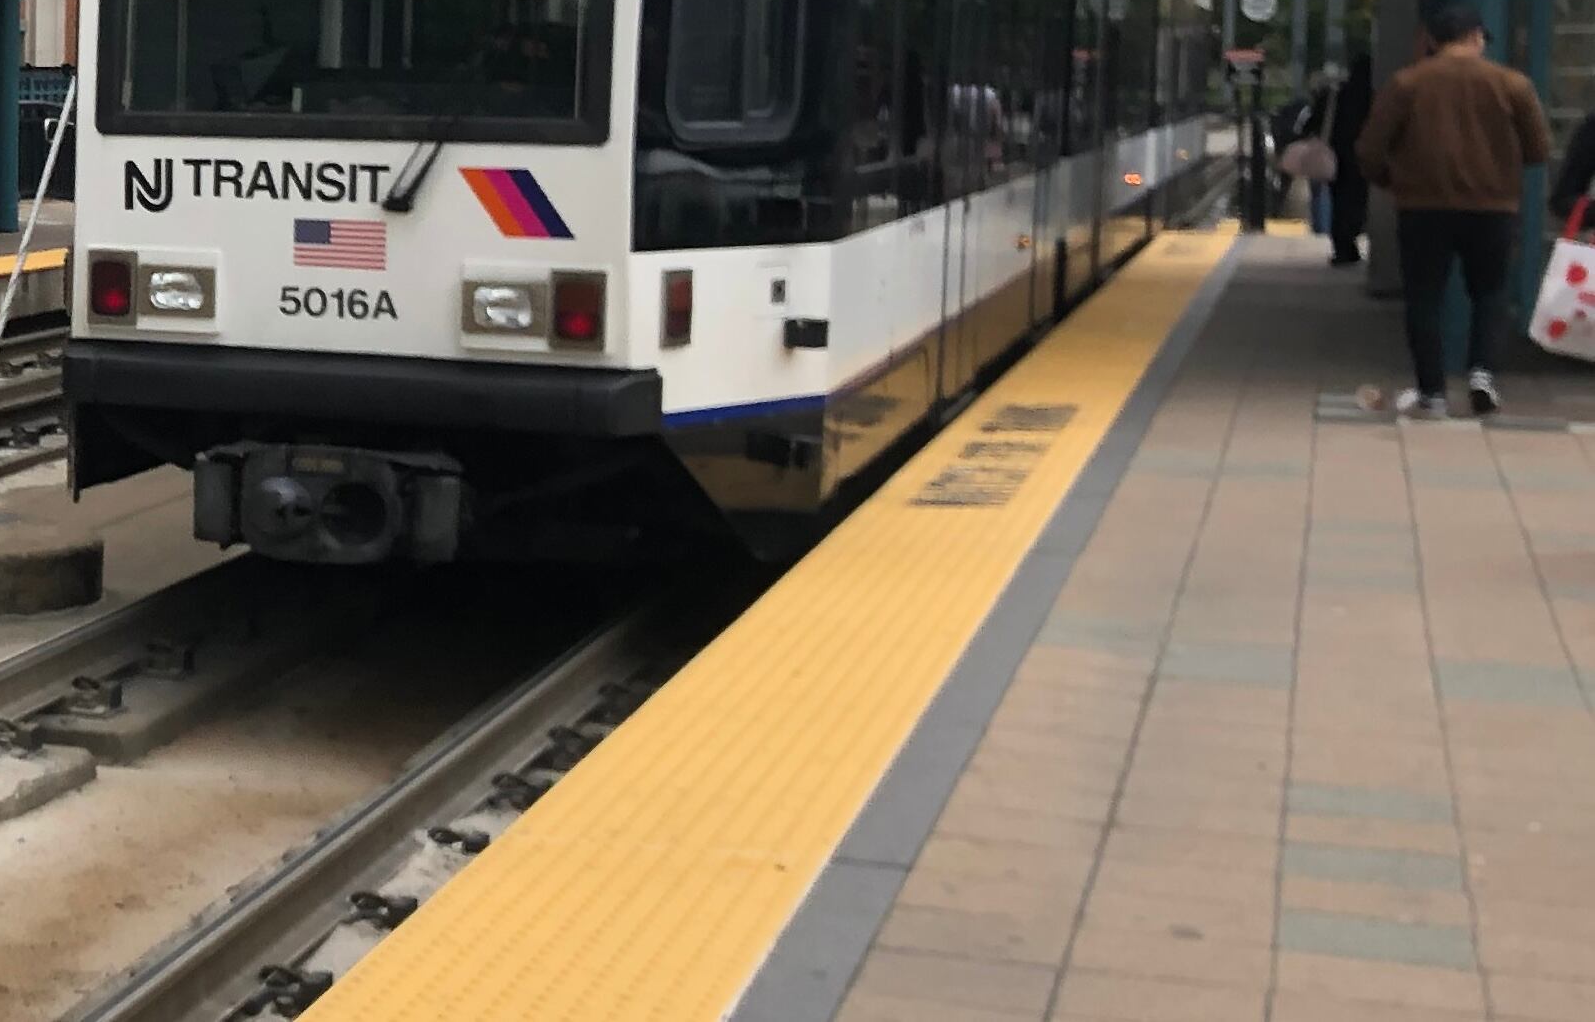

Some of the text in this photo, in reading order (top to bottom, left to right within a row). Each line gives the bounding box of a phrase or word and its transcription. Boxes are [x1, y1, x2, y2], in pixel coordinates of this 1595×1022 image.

[124, 158, 390, 212] NJ TRANSIT
[279, 286, 398, 320] 5016A
